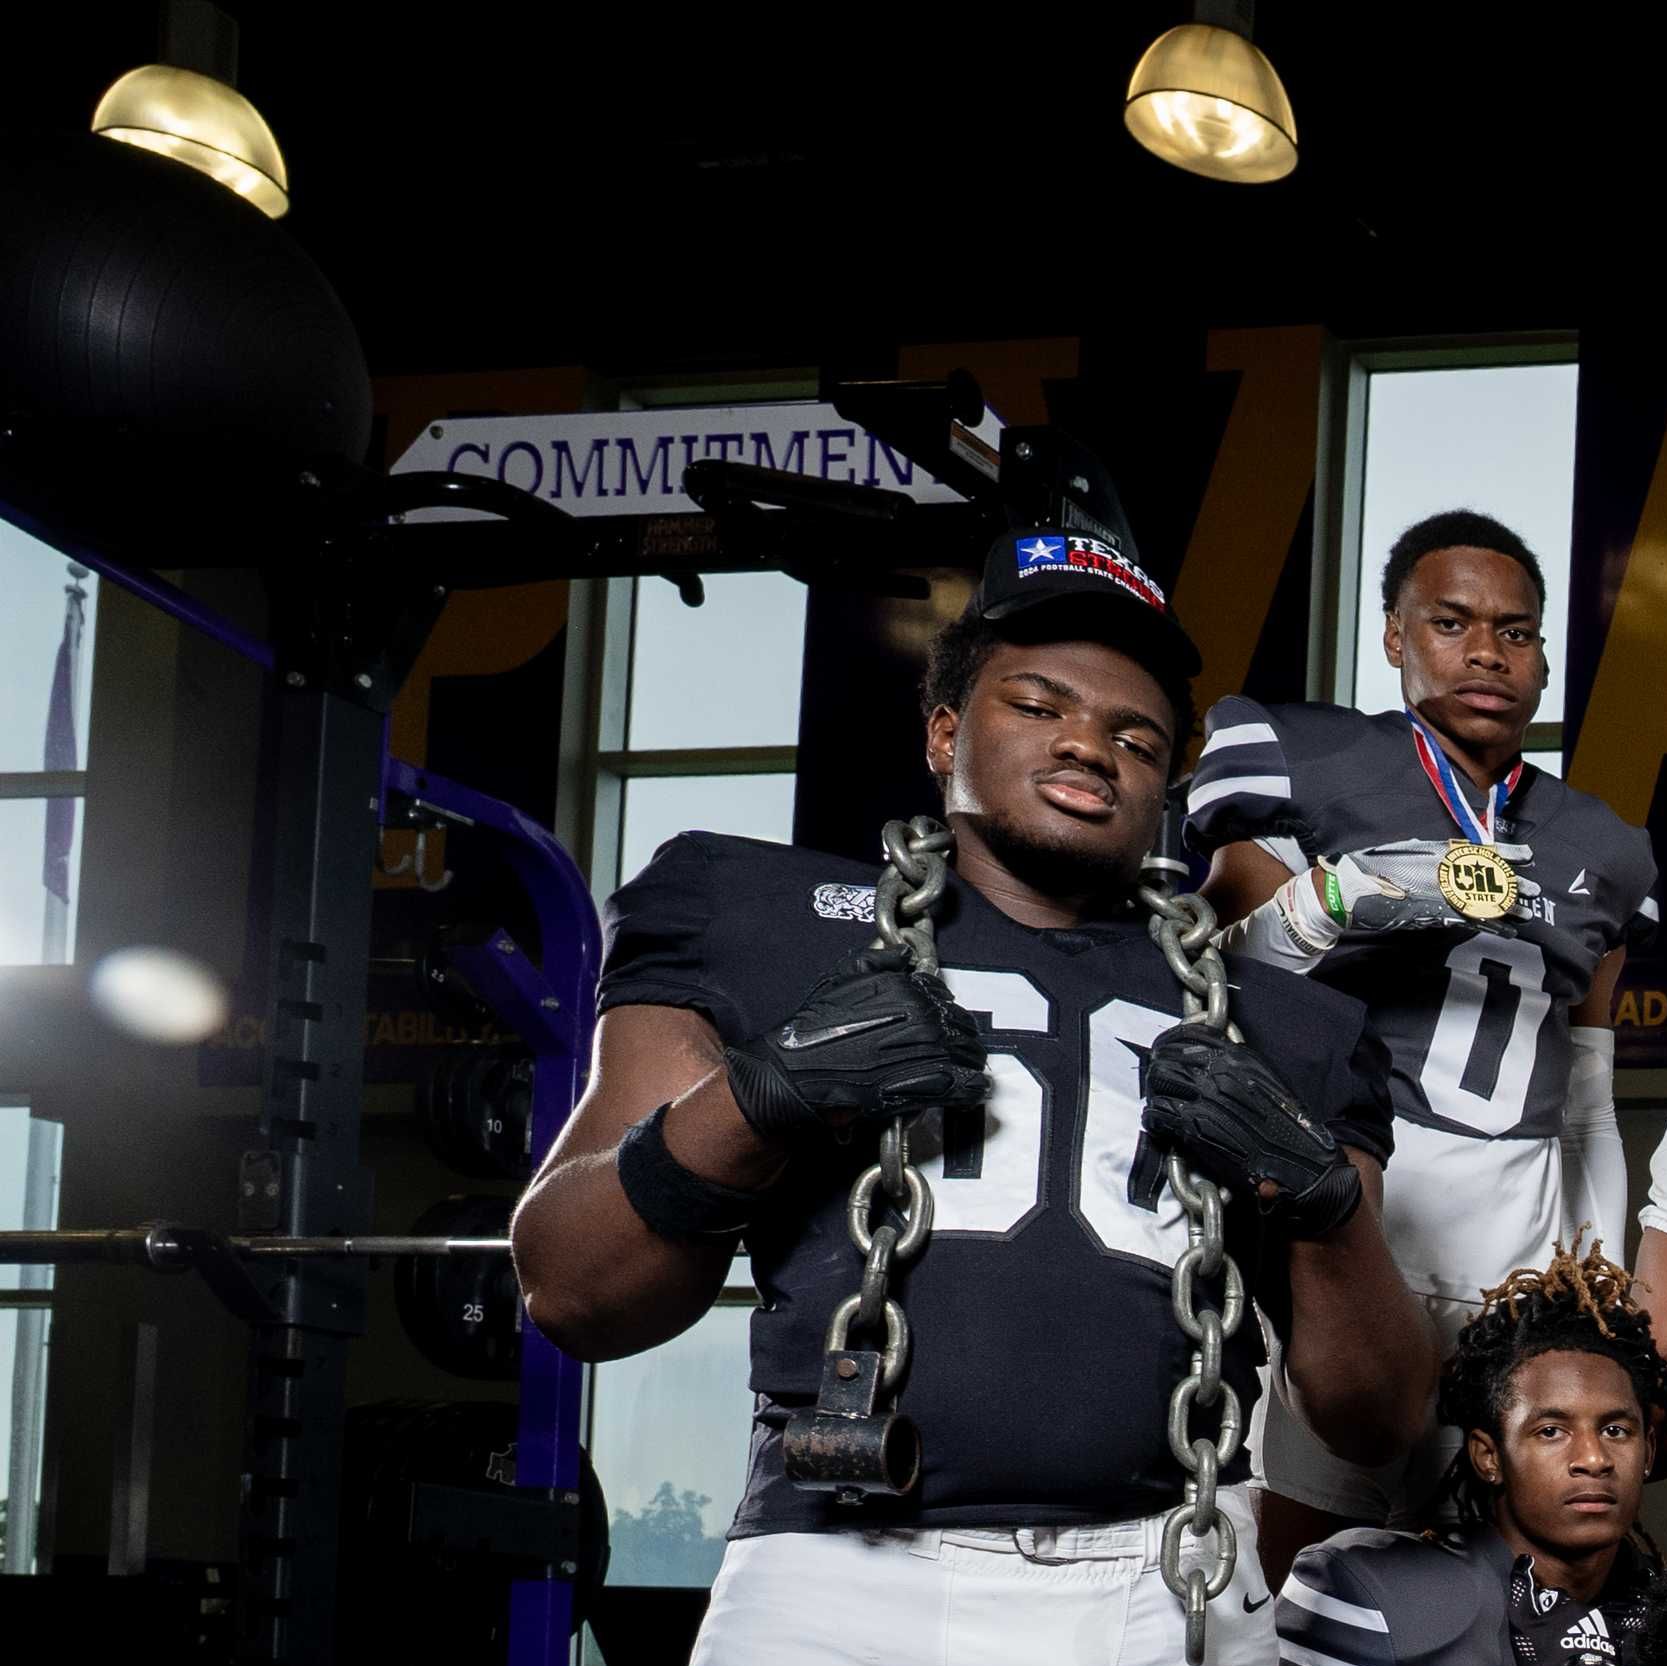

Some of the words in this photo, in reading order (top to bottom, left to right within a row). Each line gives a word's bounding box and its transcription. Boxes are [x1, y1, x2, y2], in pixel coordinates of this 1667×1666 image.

[447, 428, 940, 499] COMMITMEN
[1041, 564, 1085, 573] FOOTBALL
[1088, 566, 1113, 581] STATE
[1068, 536, 1165, 604] TEXAS
[1465, 893, 1496, 902] STATE
[1420, 931, 1551, 1135] 0
[462, 1304, 484, 1323] 25
[1560, 1633, 1616, 1656] adidas
